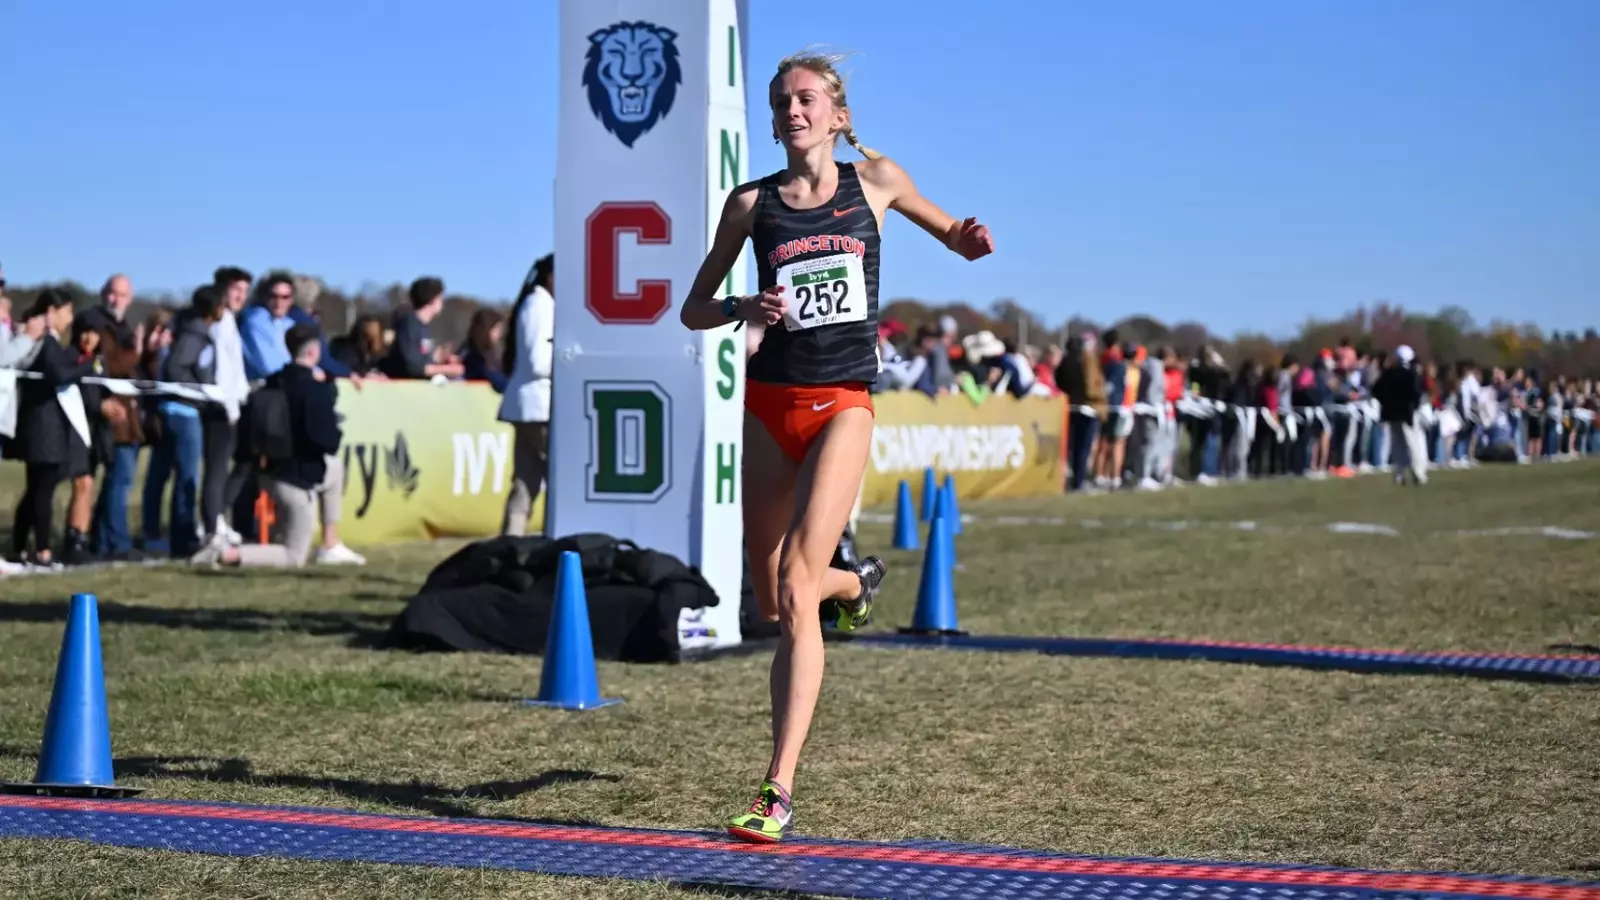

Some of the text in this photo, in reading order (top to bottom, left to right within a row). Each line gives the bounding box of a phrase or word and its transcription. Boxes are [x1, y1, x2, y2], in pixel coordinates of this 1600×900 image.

[584, 201, 672, 325] C
[768, 234, 865, 268] PRINCETON
[795, 280, 851, 320] 252
[452, 432, 509, 496] IVY
[584, 380, 672, 502] D
[871, 424, 1026, 473] CHAMPIONSHIPS
